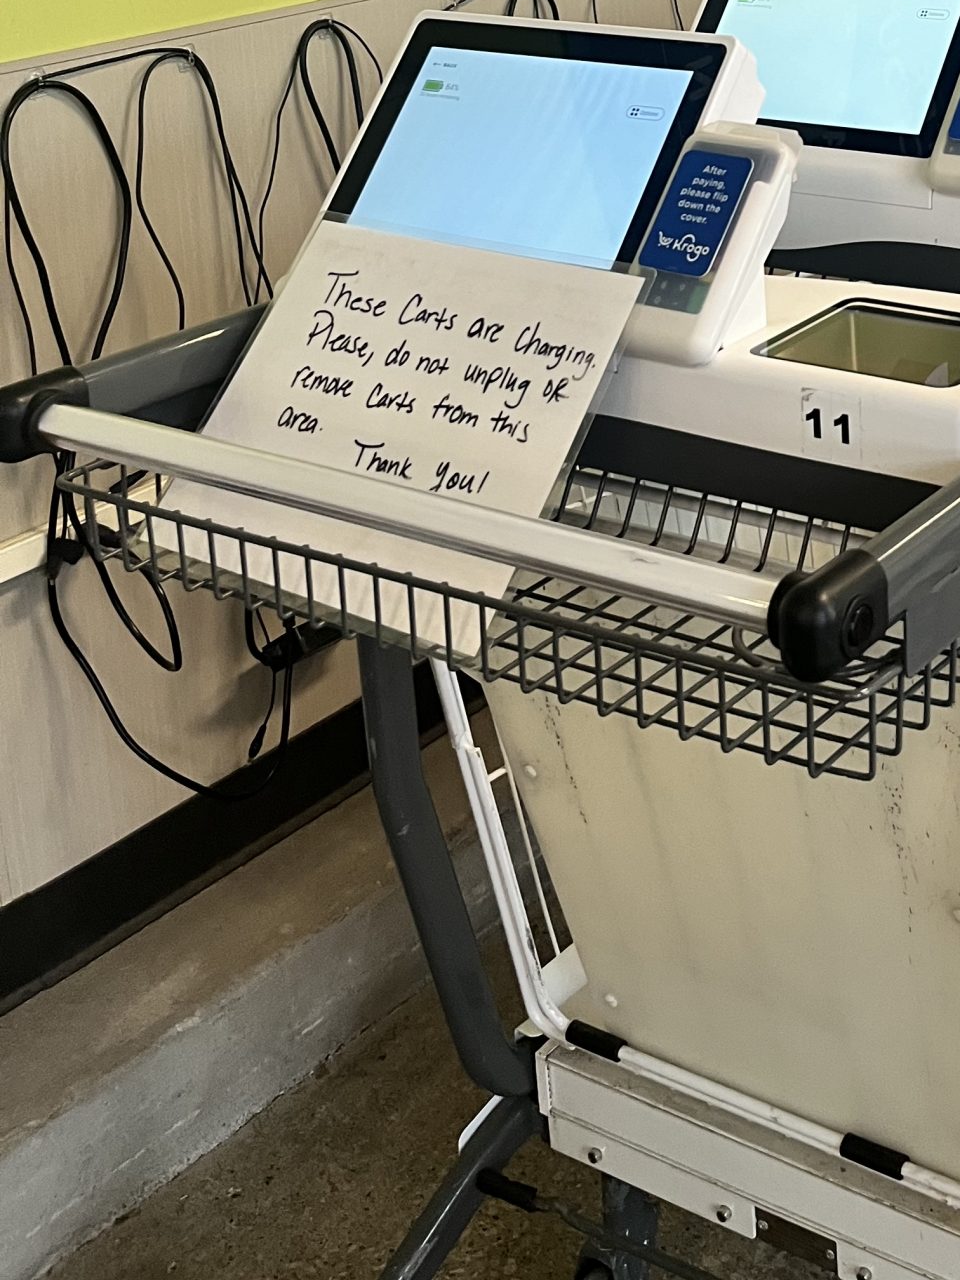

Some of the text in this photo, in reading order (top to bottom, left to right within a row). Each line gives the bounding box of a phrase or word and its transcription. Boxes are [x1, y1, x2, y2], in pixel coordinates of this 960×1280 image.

[703, 165, 727, 176] After
[678, 199, 721, 213] down the
[680, 187, 729, 203] please flip
[672, 234, 710, 262] Krogo
[323, 270, 388, 317] These
[467, 317, 505, 344] are
[305, 309, 375, 368] Please,
[384, 339, 411, 367] do
[415, 355, 450, 375] not
[464, 363, 532, 409] unplug
[290, 365, 353, 399] remove
[432, 394, 480, 432] from
[490, 410, 531, 444] this
[277, 406, 324, 436] area.
[354, 438, 413, 482] Thank
[805, 407, 850, 445] 11
